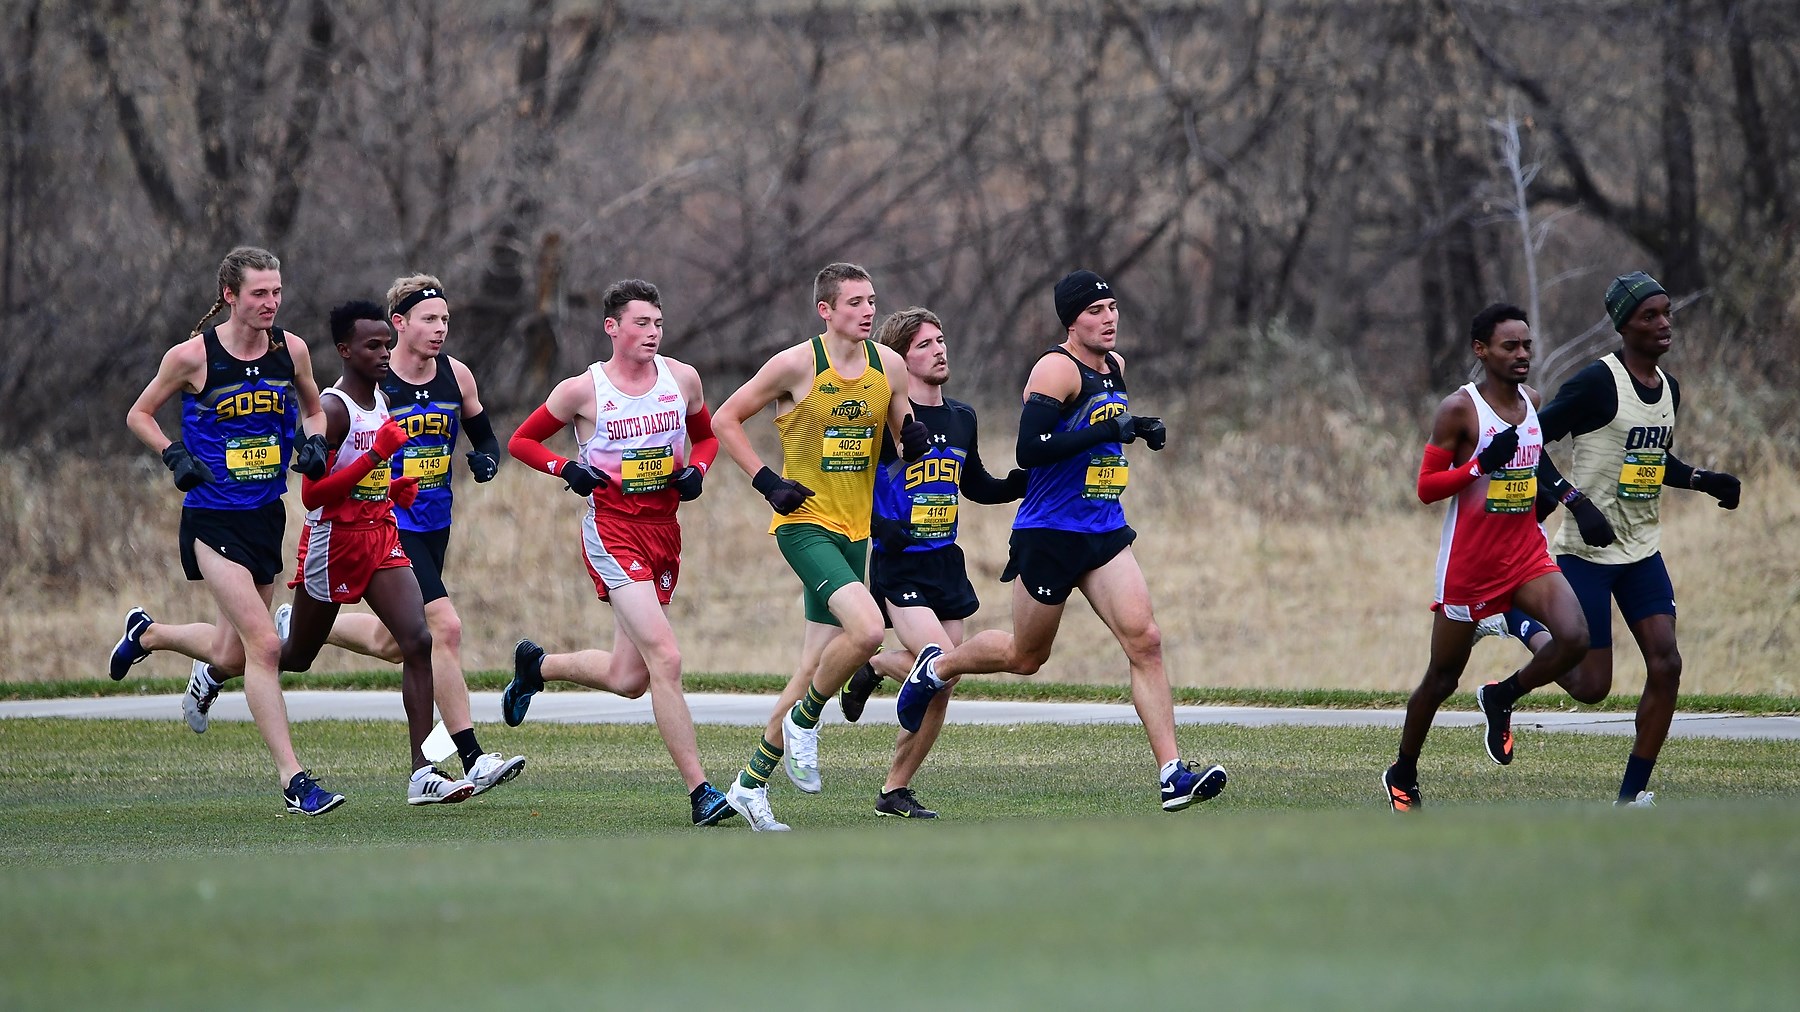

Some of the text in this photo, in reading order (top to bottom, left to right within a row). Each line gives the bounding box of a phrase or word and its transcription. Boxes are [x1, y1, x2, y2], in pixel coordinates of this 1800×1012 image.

[216, 390, 286, 422] SDSU
[831, 406, 859, 417] NDSU
[607, 410, 681, 440] SOUTH DAKOTA
[354, 430, 378, 450] SOUT
[838, 440, 862, 450] 4023
[242, 448, 267, 460] 4149
[419, 458, 440, 469] 4143
[638, 460, 662, 471] 4108
[370, 470, 385, 480] 4099
[1637, 467, 1656, 477] 4068
[1505, 481, 1529, 492] 4103
[927, 507, 948, 517] 4141
